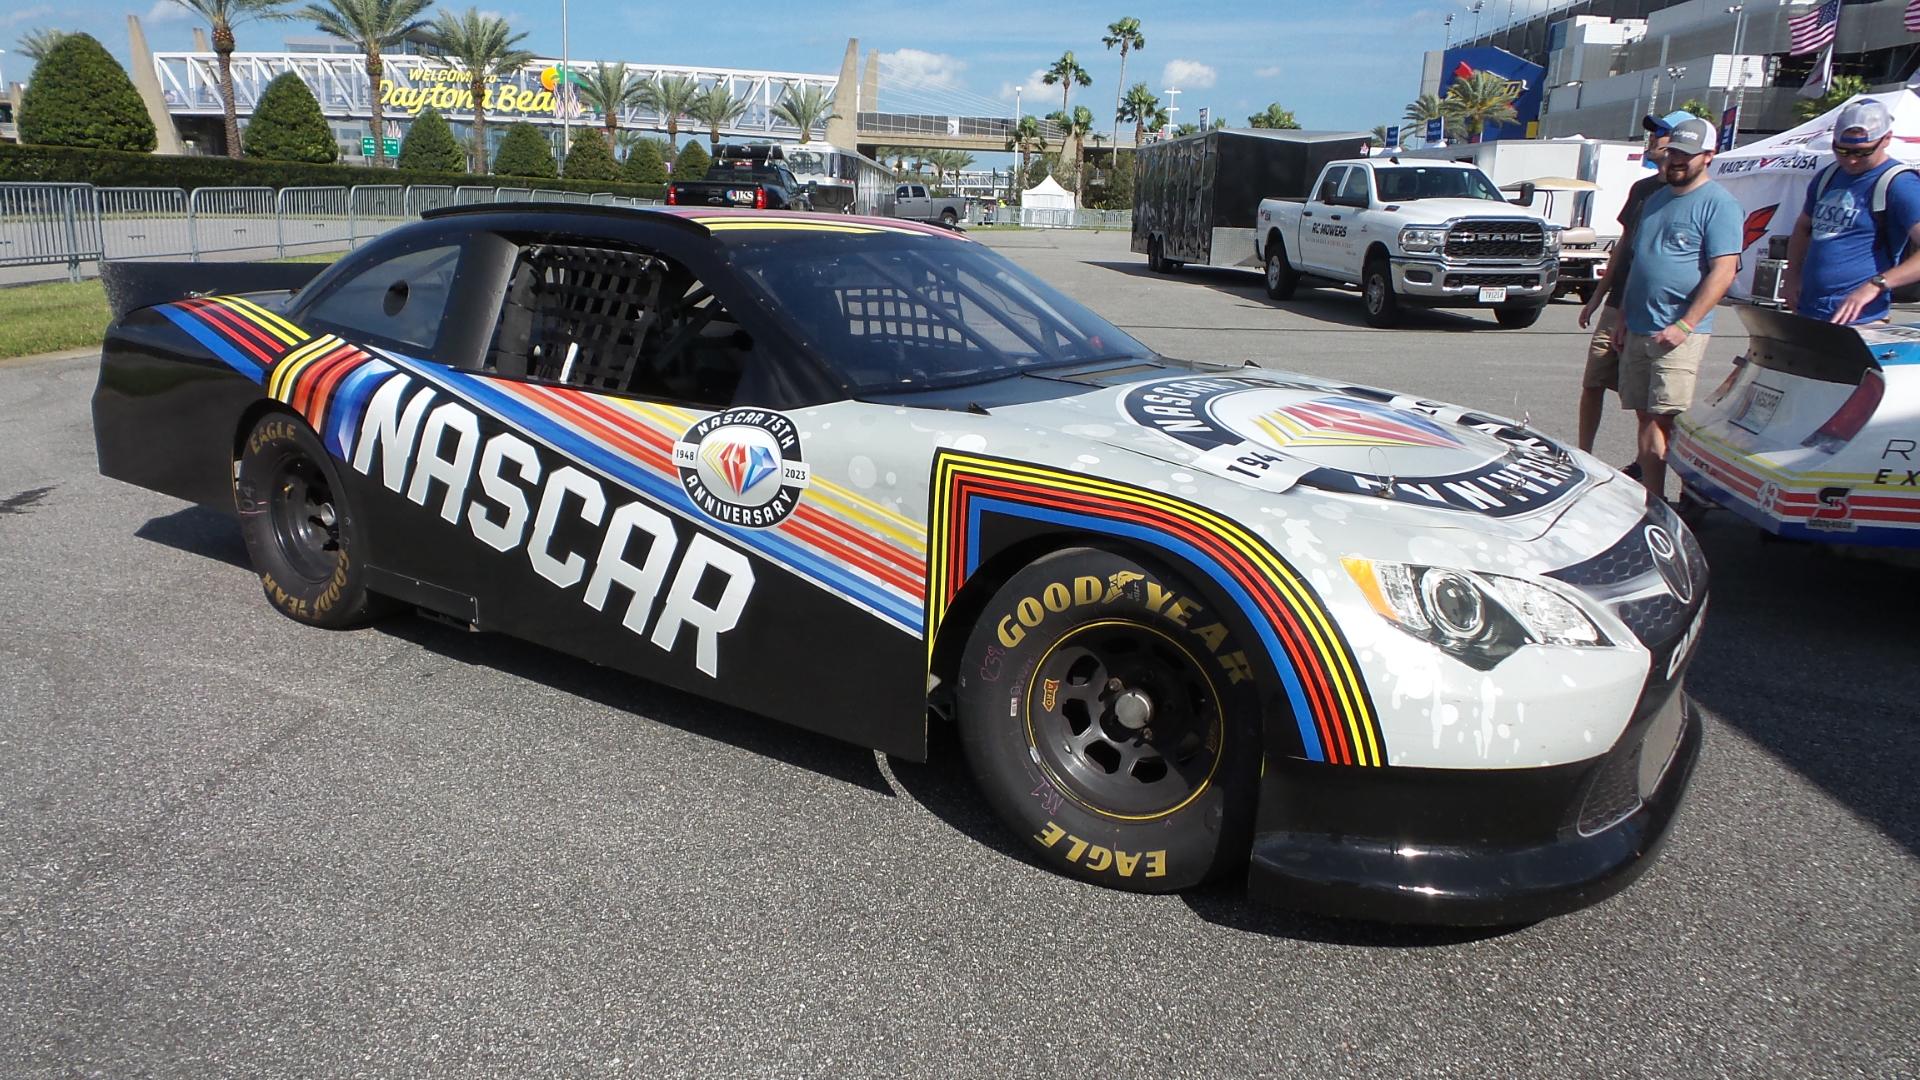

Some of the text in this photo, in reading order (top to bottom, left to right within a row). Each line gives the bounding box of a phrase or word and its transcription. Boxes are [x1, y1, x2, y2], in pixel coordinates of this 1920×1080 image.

[409, 68, 473, 82] WELCOM
[497, 84, 557, 112] Bea
[1718, 161, 1744, 175] MADE
[1791, 155, 1818, 170] USA
[735, 190, 754, 202] JKS
[1814, 203, 1859, 227] USCH
[1312, 223, 1348, 238] RC MOWERS
[1477, 233, 1519, 241] RAM
[250, 422, 297, 454] EAGLE
[697, 411, 796, 450] NASCAR 75TH
[675, 450, 694, 461] 1948
[785, 468, 806, 480] 2023
[686, 474, 792, 525] ANNIVERSARY
[353, 373, 756, 679] NASCAR
[1033, 821, 1167, 877] EAGLE
